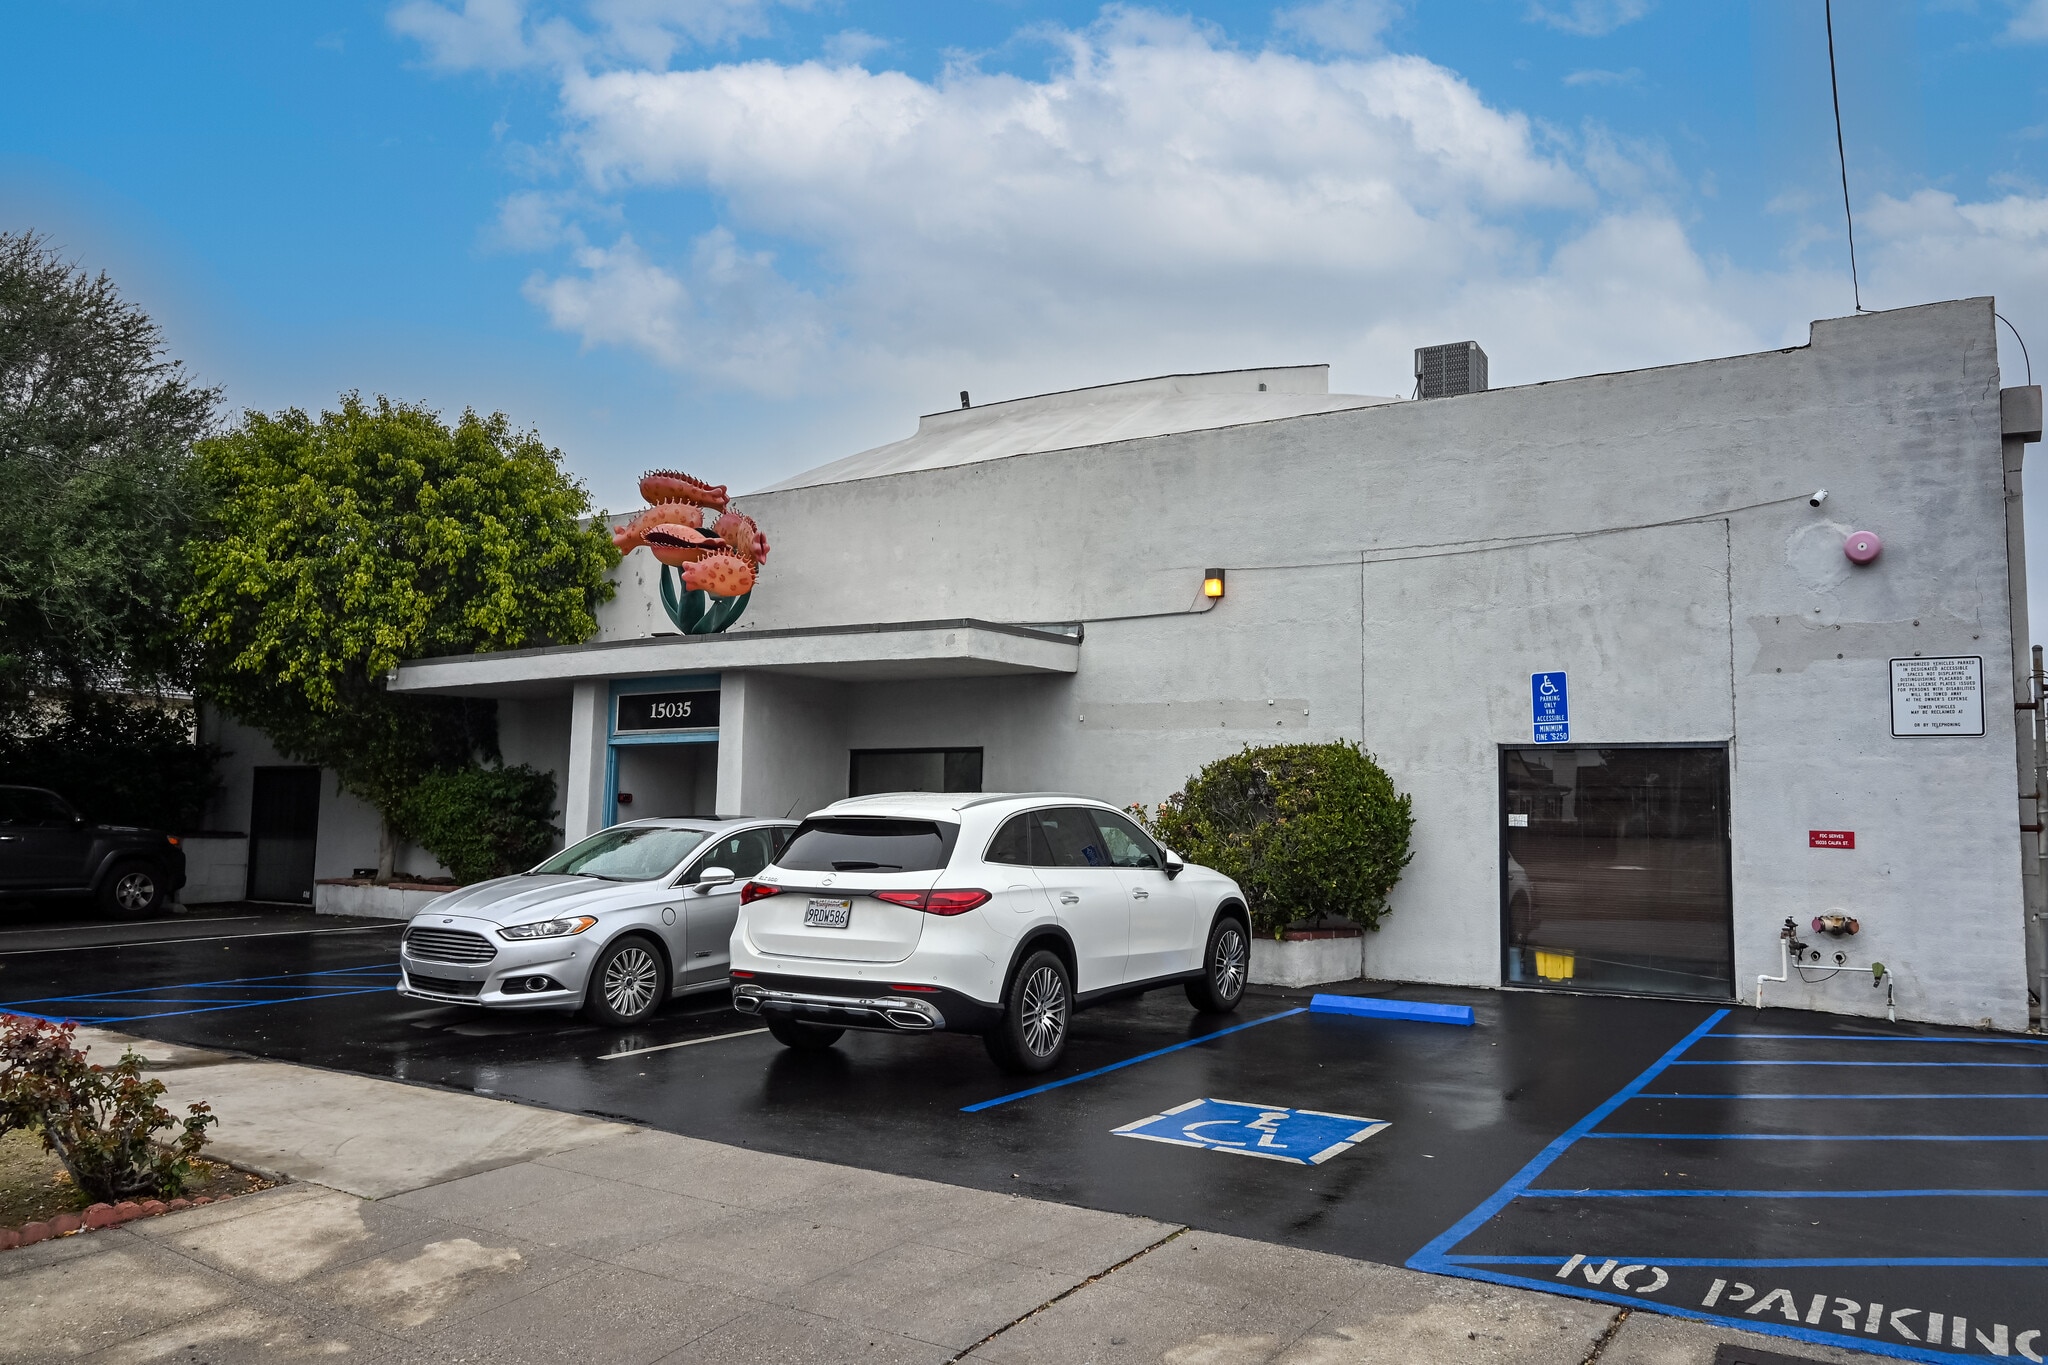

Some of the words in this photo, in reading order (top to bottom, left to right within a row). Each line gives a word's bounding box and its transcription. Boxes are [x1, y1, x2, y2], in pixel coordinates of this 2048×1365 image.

[650, 700, 691, 718] 15035
[1536, 733, 1547, 741] FINE
[808, 909, 846, 923] 9RDW586
[1556, 1253, 1669, 1293] NO
